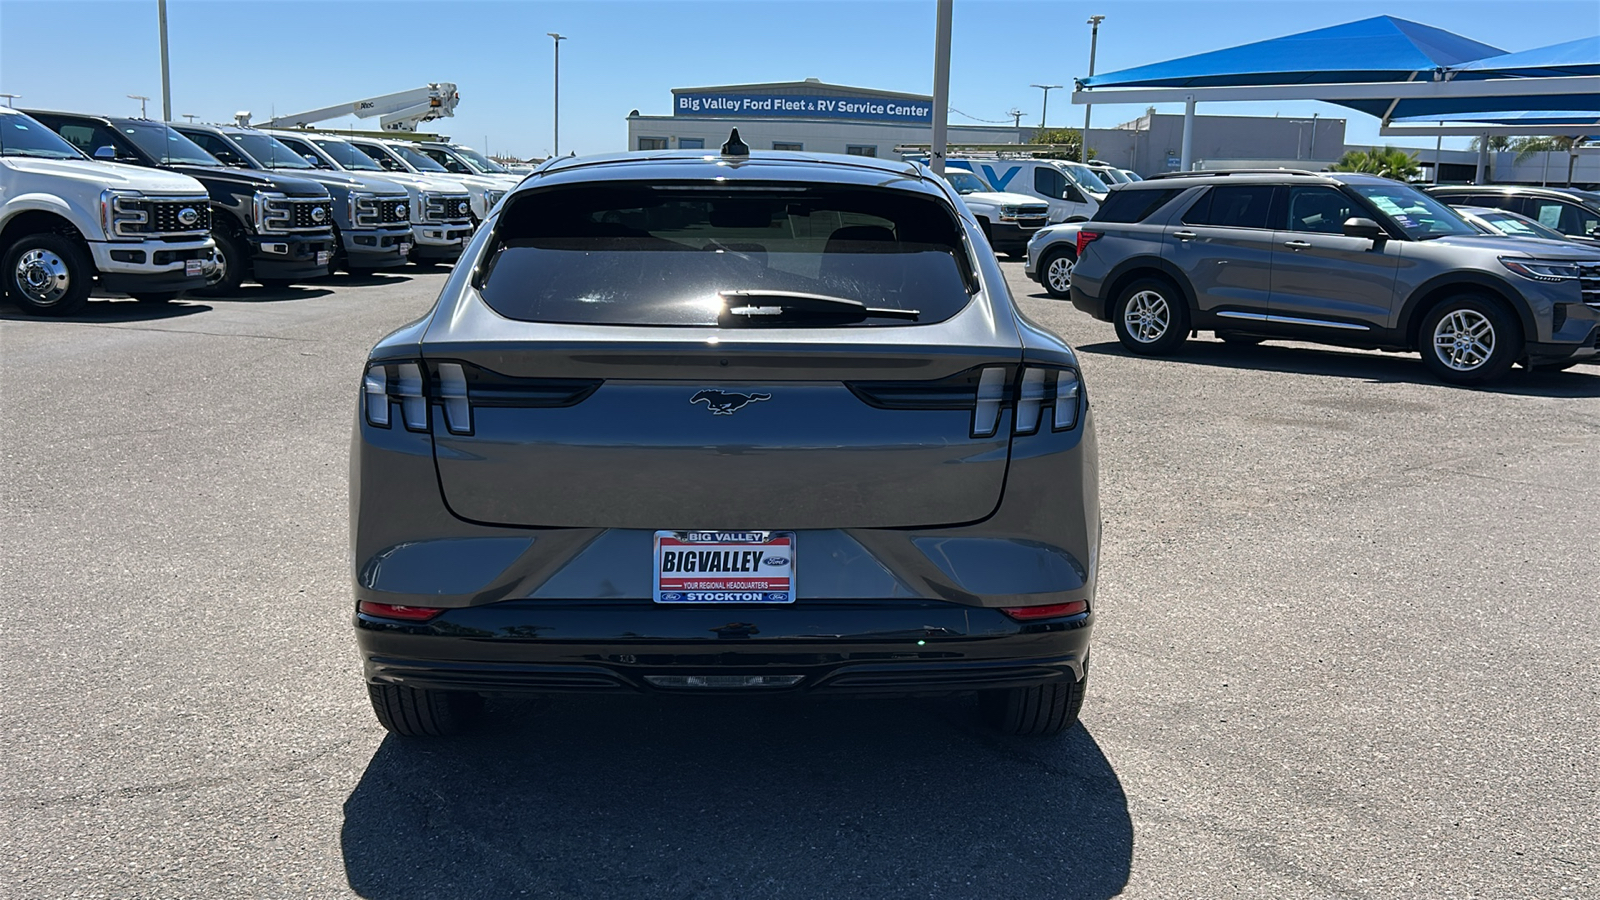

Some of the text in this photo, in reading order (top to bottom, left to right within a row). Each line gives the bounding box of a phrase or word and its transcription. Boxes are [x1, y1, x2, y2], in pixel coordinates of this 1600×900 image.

[679, 97, 929, 117] Big Valley Ford Fleet & RV Service Center
[689, 533, 762, 542] BIG VALLEY
[662, 551, 785, 573] BIGVALLEY Ford
[687, 592, 763, 601] STOCKTON
